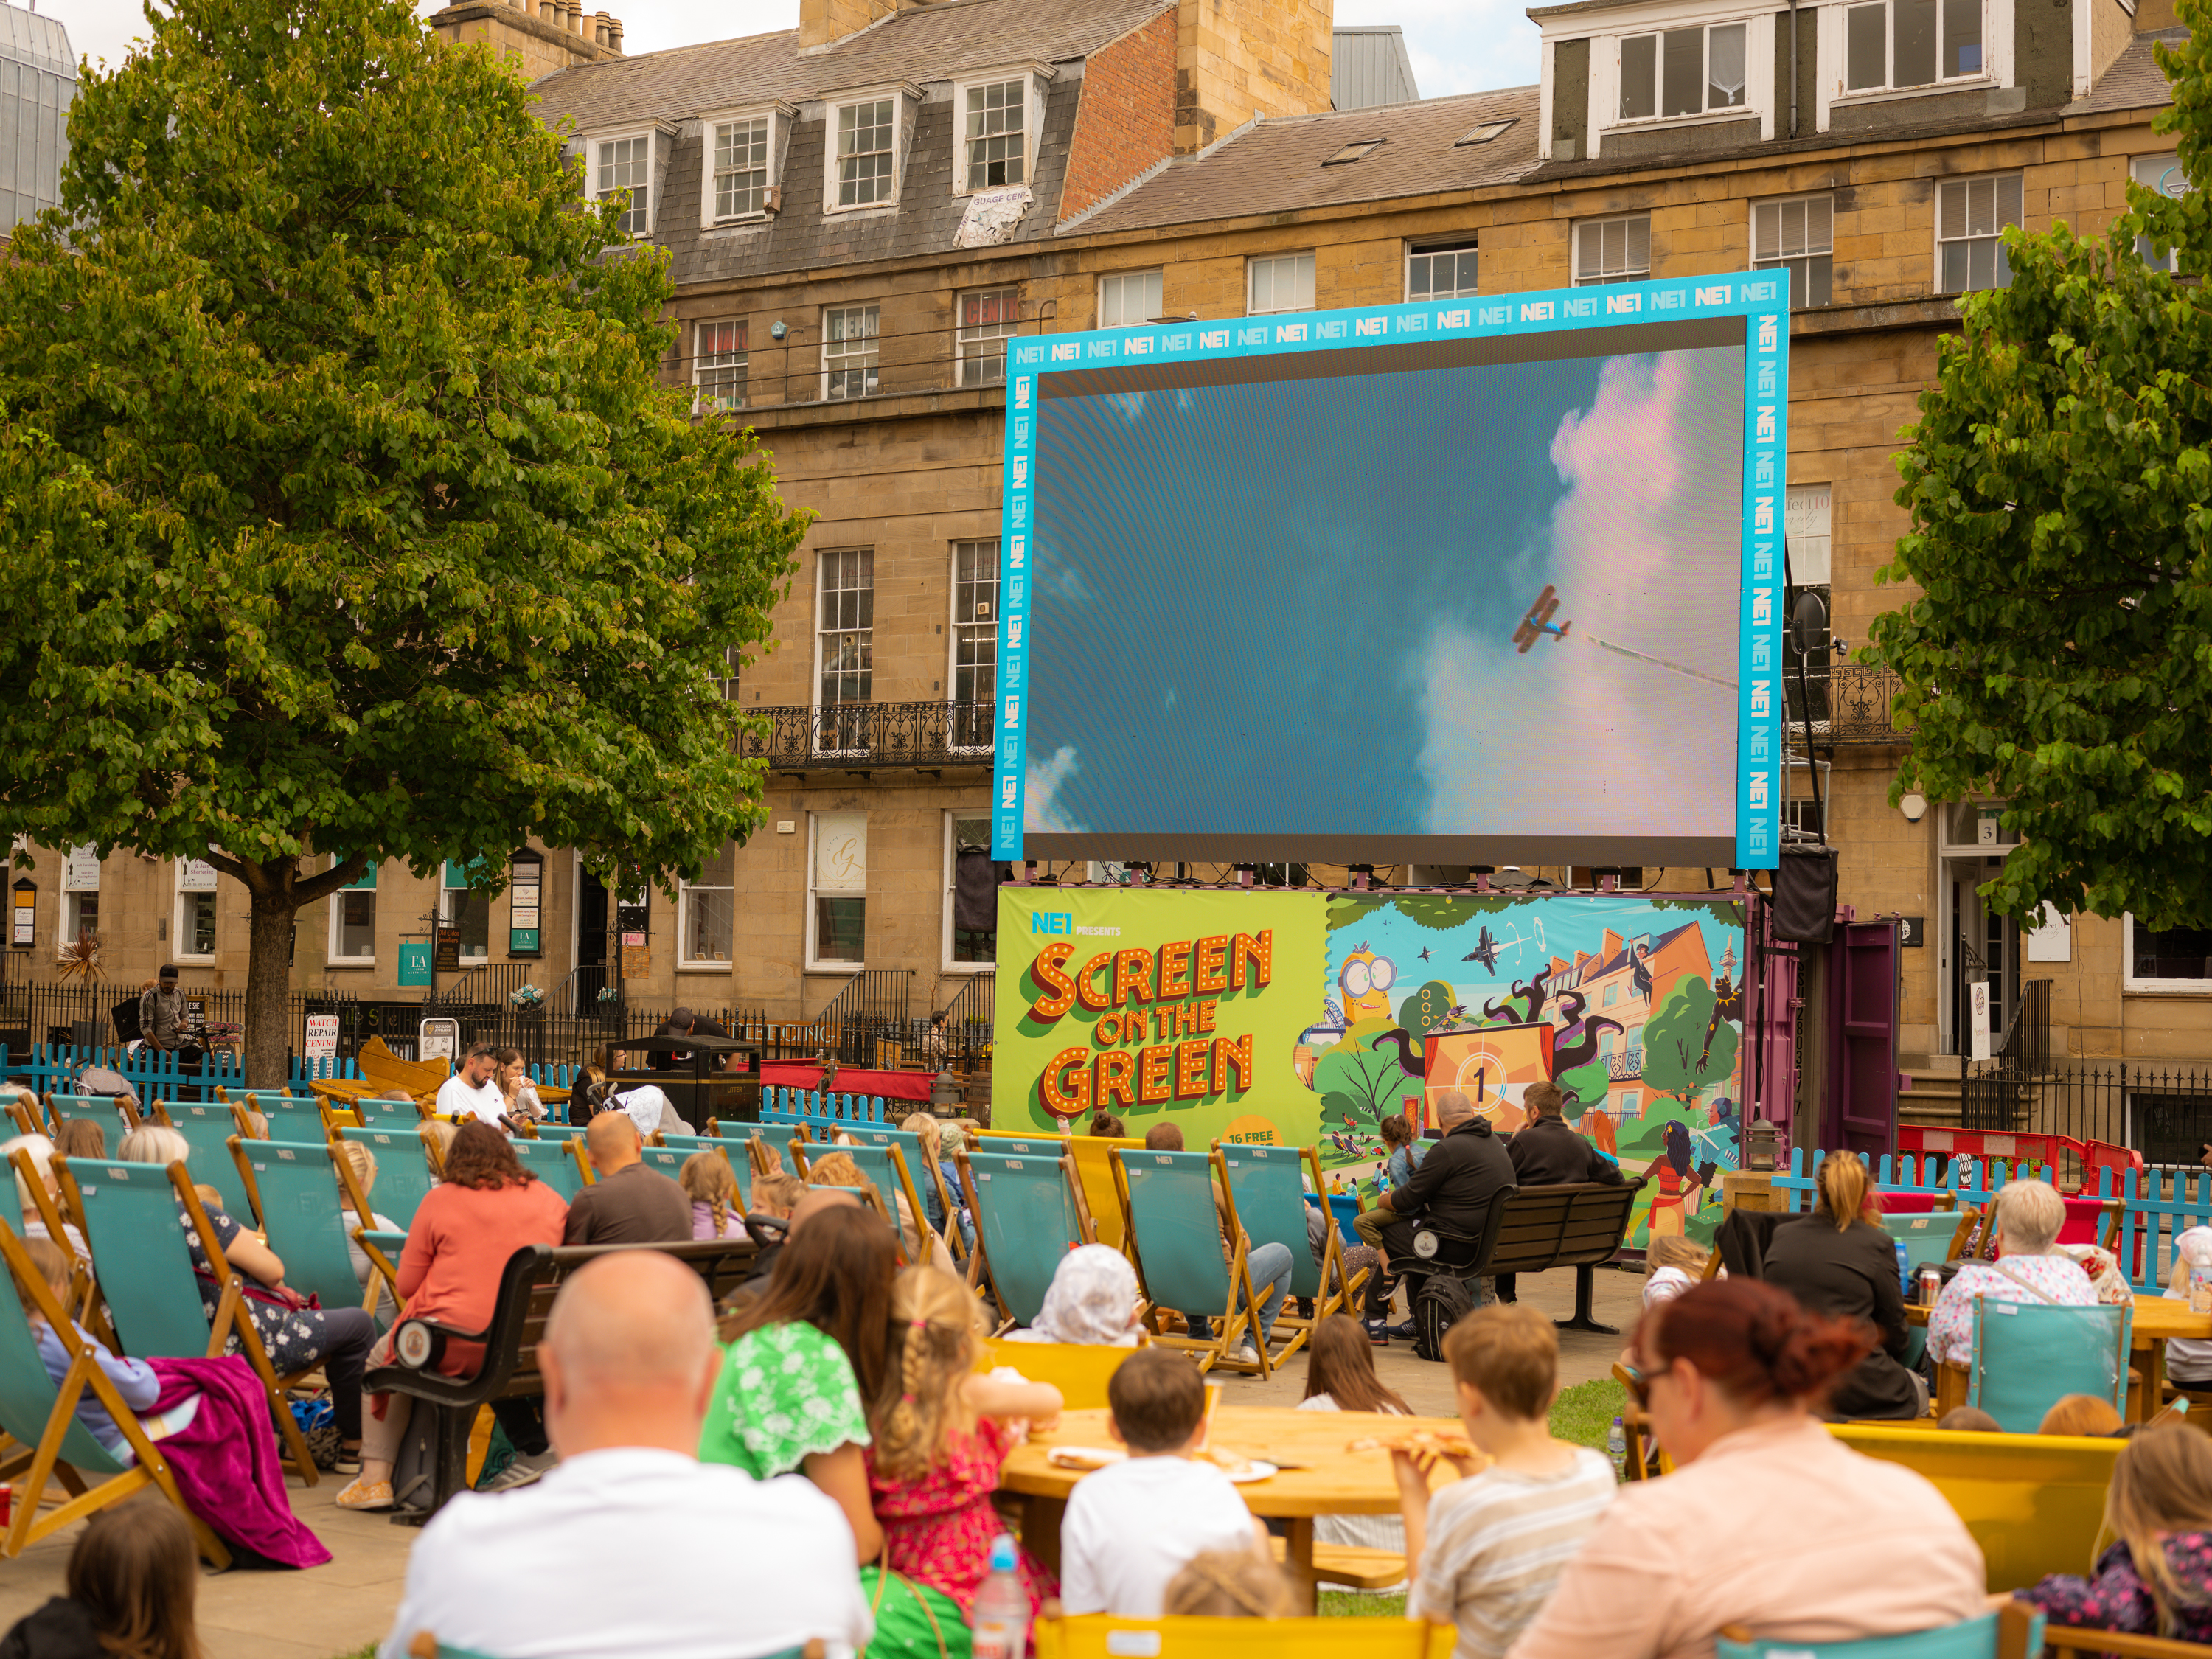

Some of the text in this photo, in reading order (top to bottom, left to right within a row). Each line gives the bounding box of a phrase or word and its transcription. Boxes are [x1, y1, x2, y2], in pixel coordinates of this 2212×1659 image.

[1018, 282, 1777, 364] NE1 NE1 NE1 NE1 NE1 NE1 NE1 NE1 NE1 NE1 NE1 NE1 NE1 NE1 NE1 NE1 NE1 NE1 NE1
[1750, 315, 1778, 855] NE1 NE1 NE1 NE1 NE1 NE1 NE1 NE1 NE1 NE1 NE1 NE1
[1001, 377, 1031, 848] NE1 NE1 NE1 NE1 NE1 NE1 NE1 NE1 NE1 NE1 NE1 NE1
[1983, 826, 1992, 840] 3
[1032, 911, 1121, 936] NE1 PRESENTS
[520, 932, 529, 940] EA
[411, 955, 426, 967] EA
[1024, 929, 1273, 1025] SCREEN
[226, 1023, 239, 1031] She
[310, 1018, 337, 1027] WATCH
[1095, 1000, 1217, 1046] ON THE
[308, 1029, 336, 1037] REPAIR
[305, 1039, 336, 1048] CENTRE
[1038, 1033, 1253, 1120] GREEN
[1473, 1067, 1485, 1102] 1
[749, 1128, 765, 1136] NE1
[1228, 1130, 1273, 1144] 16 FREE
[374, 1134, 391, 1144] NE1
[873, 1134, 888, 1142] NE1
[1012, 1143, 1029, 1152] NE1
[656, 1153, 675, 1164] NE1
[1251, 1150, 1267, 1158] NE1
[1006, 1160, 1023, 1169] NE1
[1155, 1155, 1172, 1164] NE1
[1910, 1219, 1930, 1229] NE1
